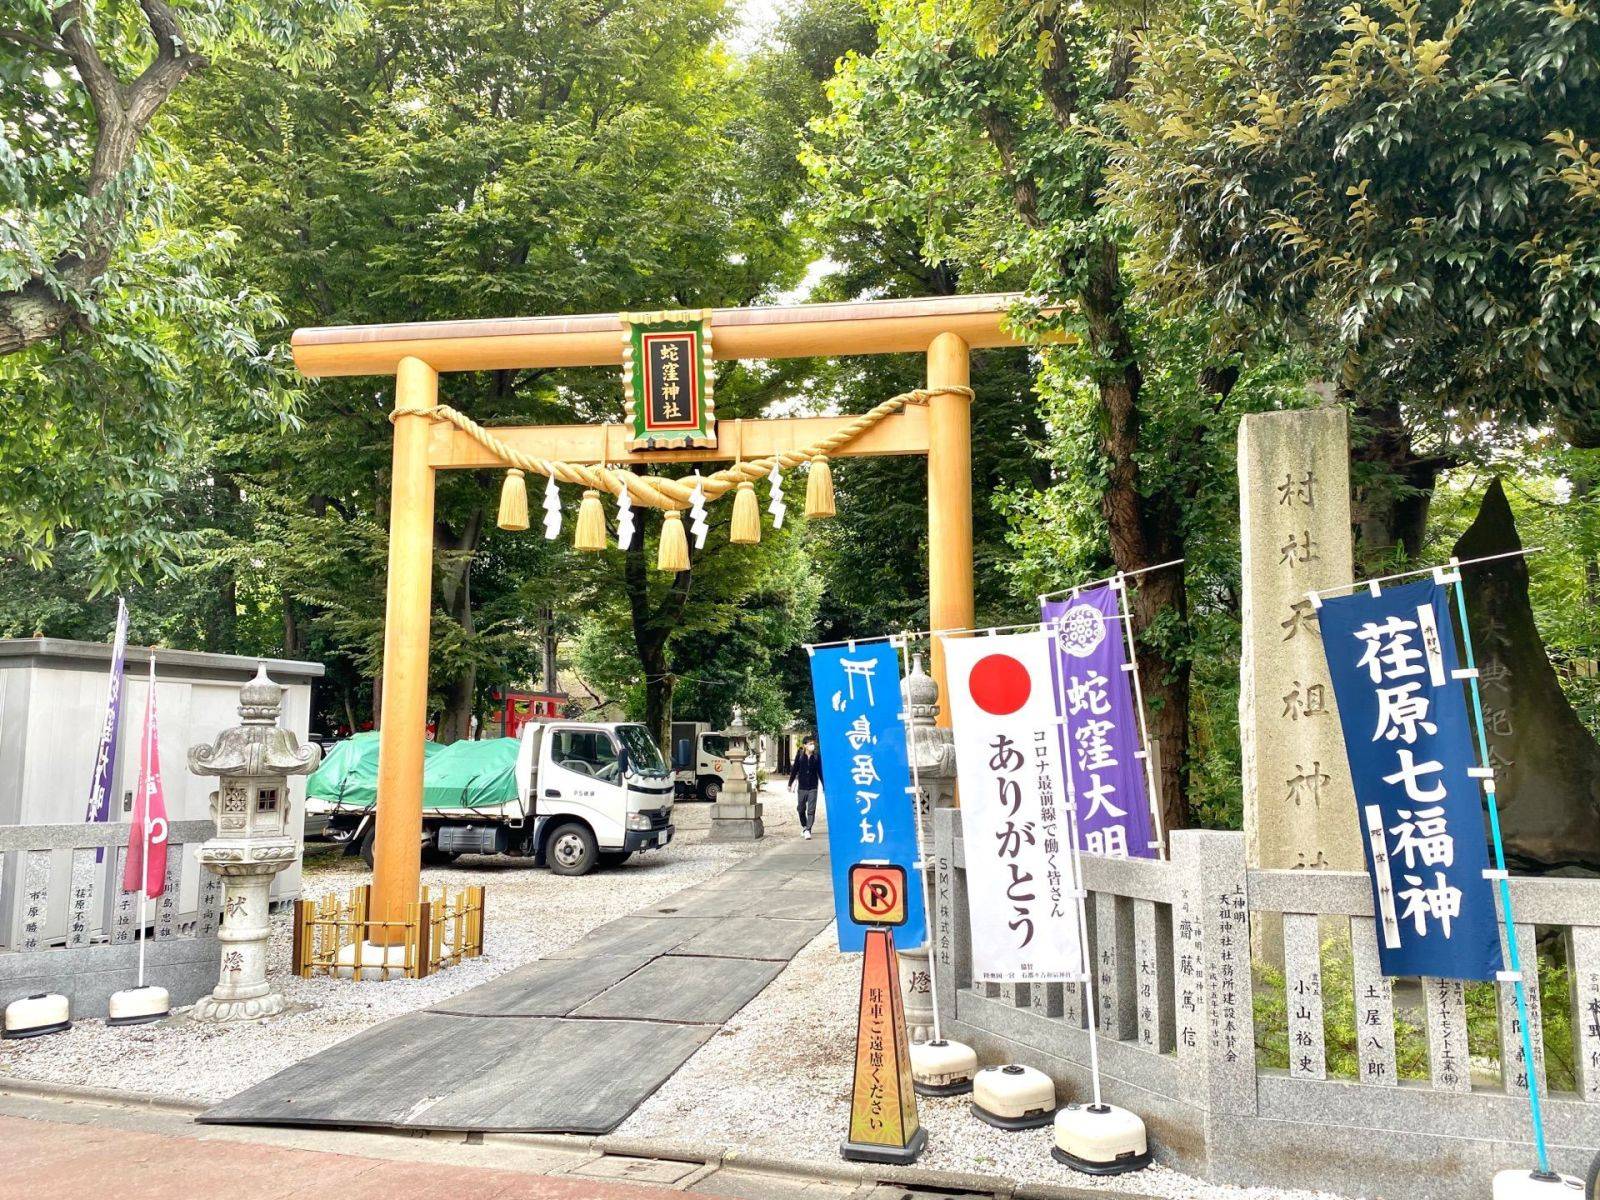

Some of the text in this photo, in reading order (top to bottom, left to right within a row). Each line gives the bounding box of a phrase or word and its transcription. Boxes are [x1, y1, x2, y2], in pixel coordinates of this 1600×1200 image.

[660, 343, 682, 419] 蛇窪神社
[989, 734, 1036, 949] ありがとう
[1033, 731, 1064, 918] コロナ最前線で働く皆さん
[1353, 616, 1462, 940] 荏原七福神
[869, 987, 883, 1129] 駐車ご遠慮ください
[1294, 980, 1315, 1073] 小山裕史
[1364, 985, 1386, 1078] 土屋八郎
